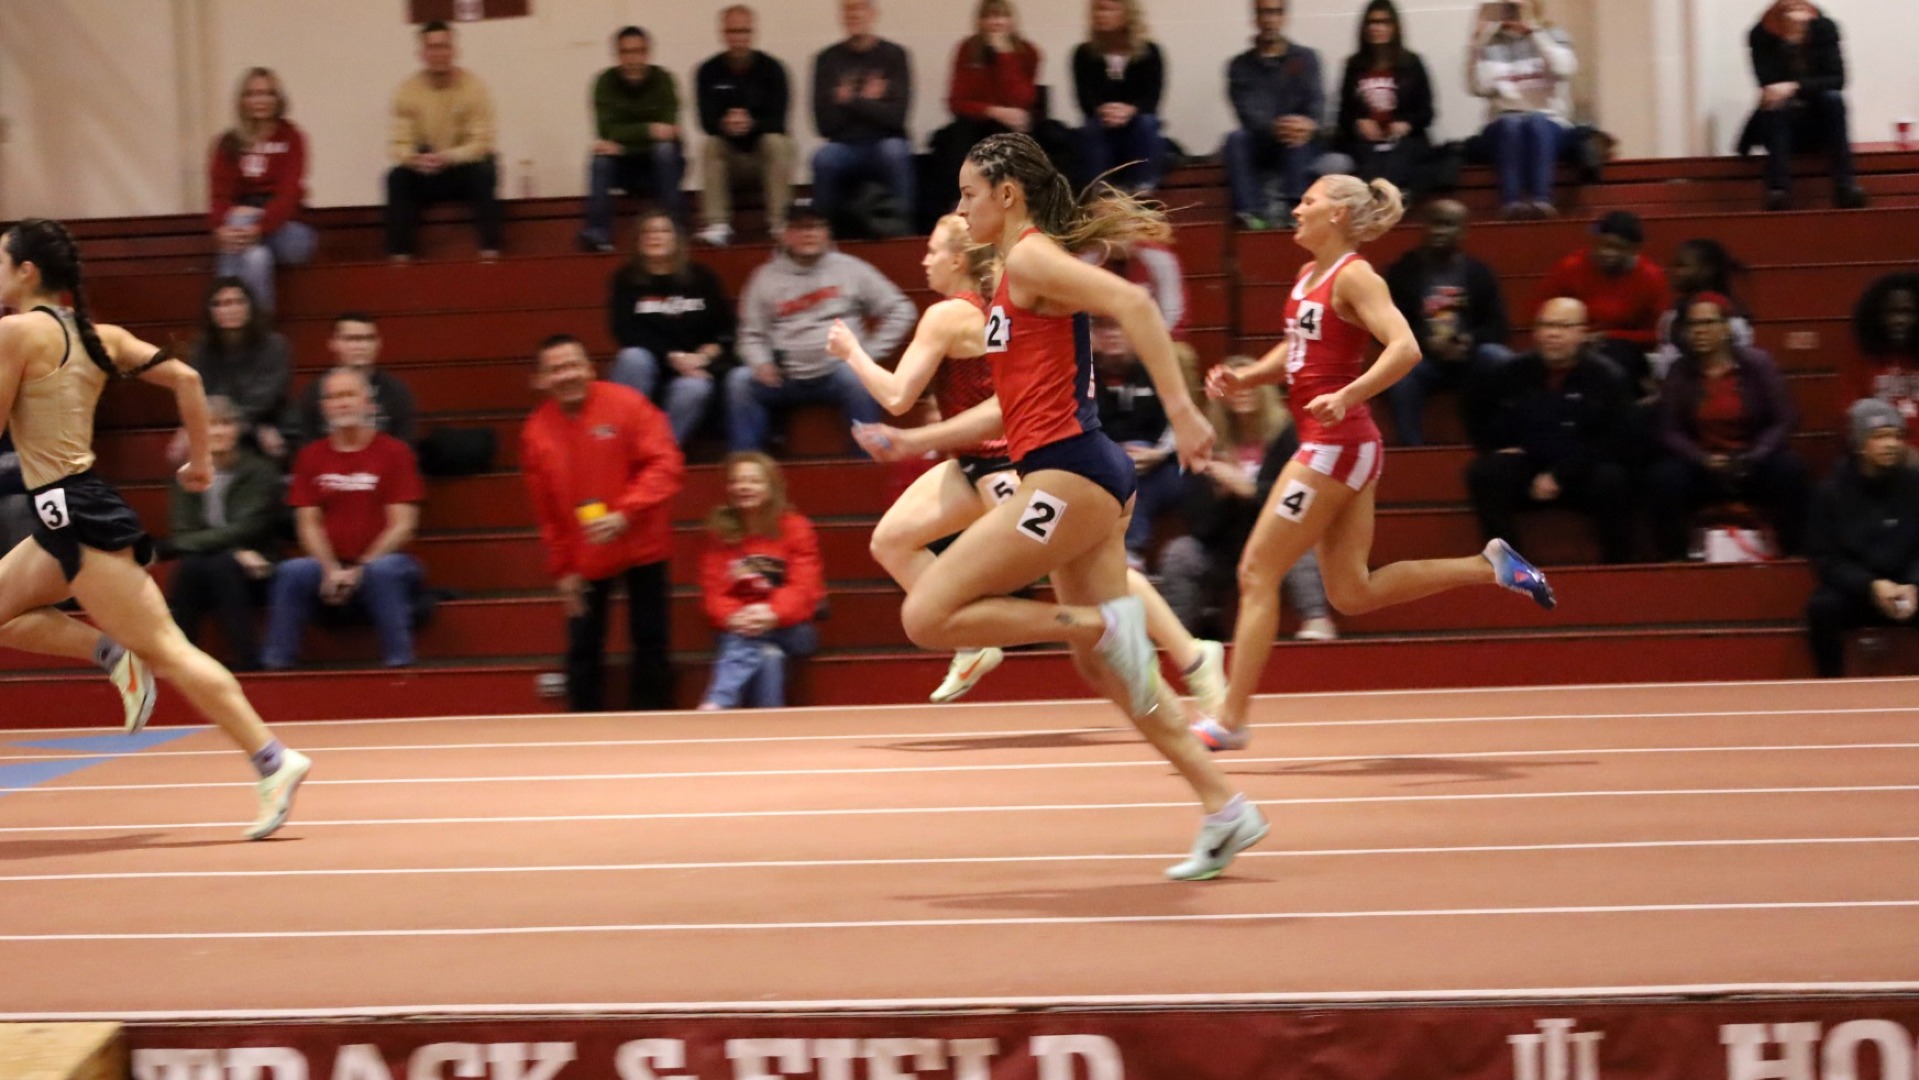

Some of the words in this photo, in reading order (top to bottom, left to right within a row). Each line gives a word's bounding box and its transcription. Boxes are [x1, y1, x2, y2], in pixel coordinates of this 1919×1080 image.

[987, 315, 1002, 347] 2
[1300, 308, 1316, 334] 4
[993, 481, 1015, 499] 5
[1282, 491, 1307, 516] 4
[41, 500, 63, 527] 3
[1021, 501, 1056, 538] 2
[1718, 1018, 1919, 1080] HO
